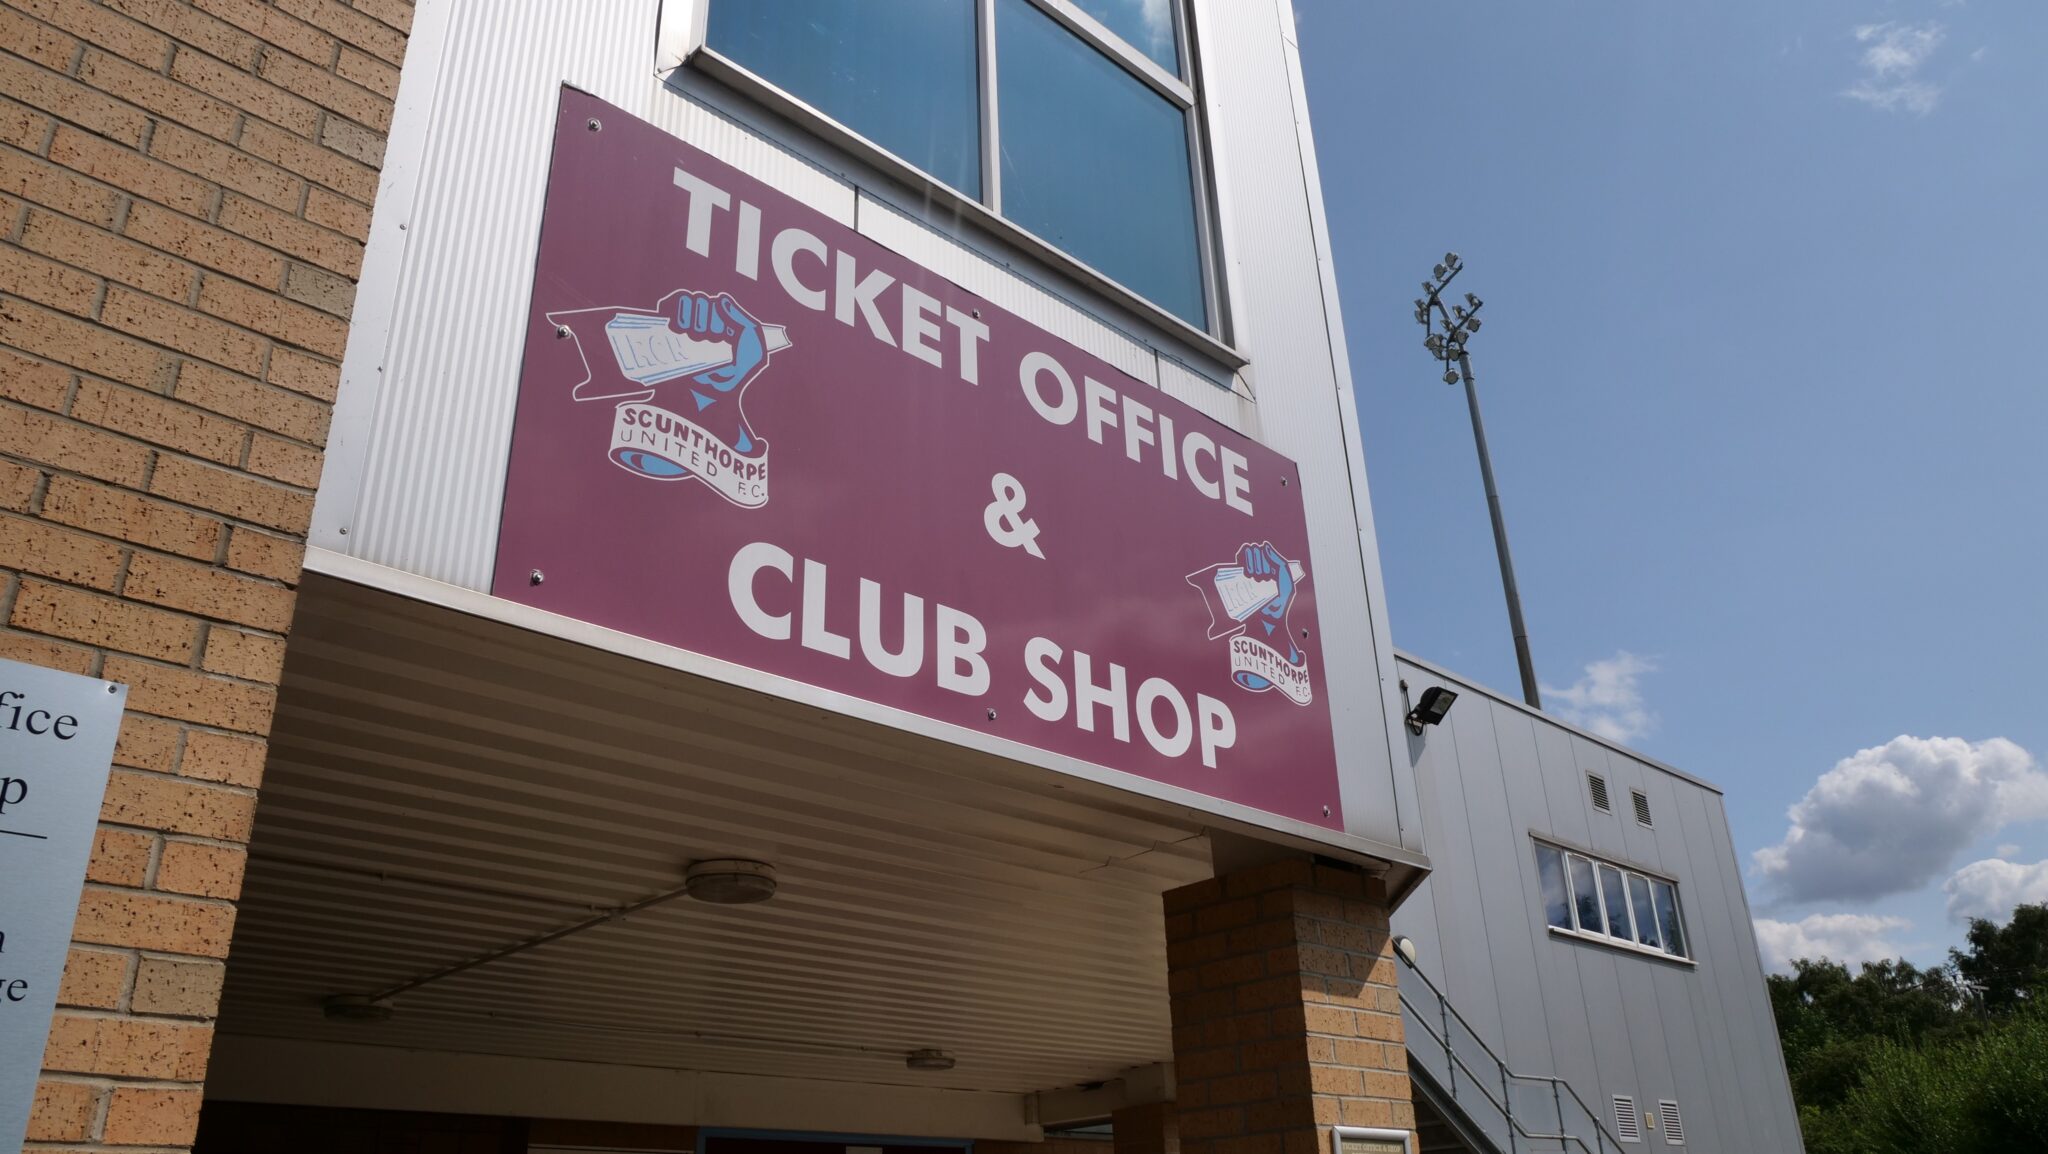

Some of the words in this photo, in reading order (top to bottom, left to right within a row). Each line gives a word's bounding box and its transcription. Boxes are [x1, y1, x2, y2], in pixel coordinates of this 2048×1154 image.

[673, 166, 990, 385] TICKET
[1019, 351, 1253, 516] OFFICE
[620, 429, 718, 477] UNITED
[622, 408, 766, 481] SCUNTHORPE
[983, 472, 1046, 560] &
[728, 542, 991, 697] CLUB
[1023, 636, 1237, 769] SHOP
[1233, 640, 1309, 685] SCUNTHORPE
[1234, 655, 1285, 685] UNITED
